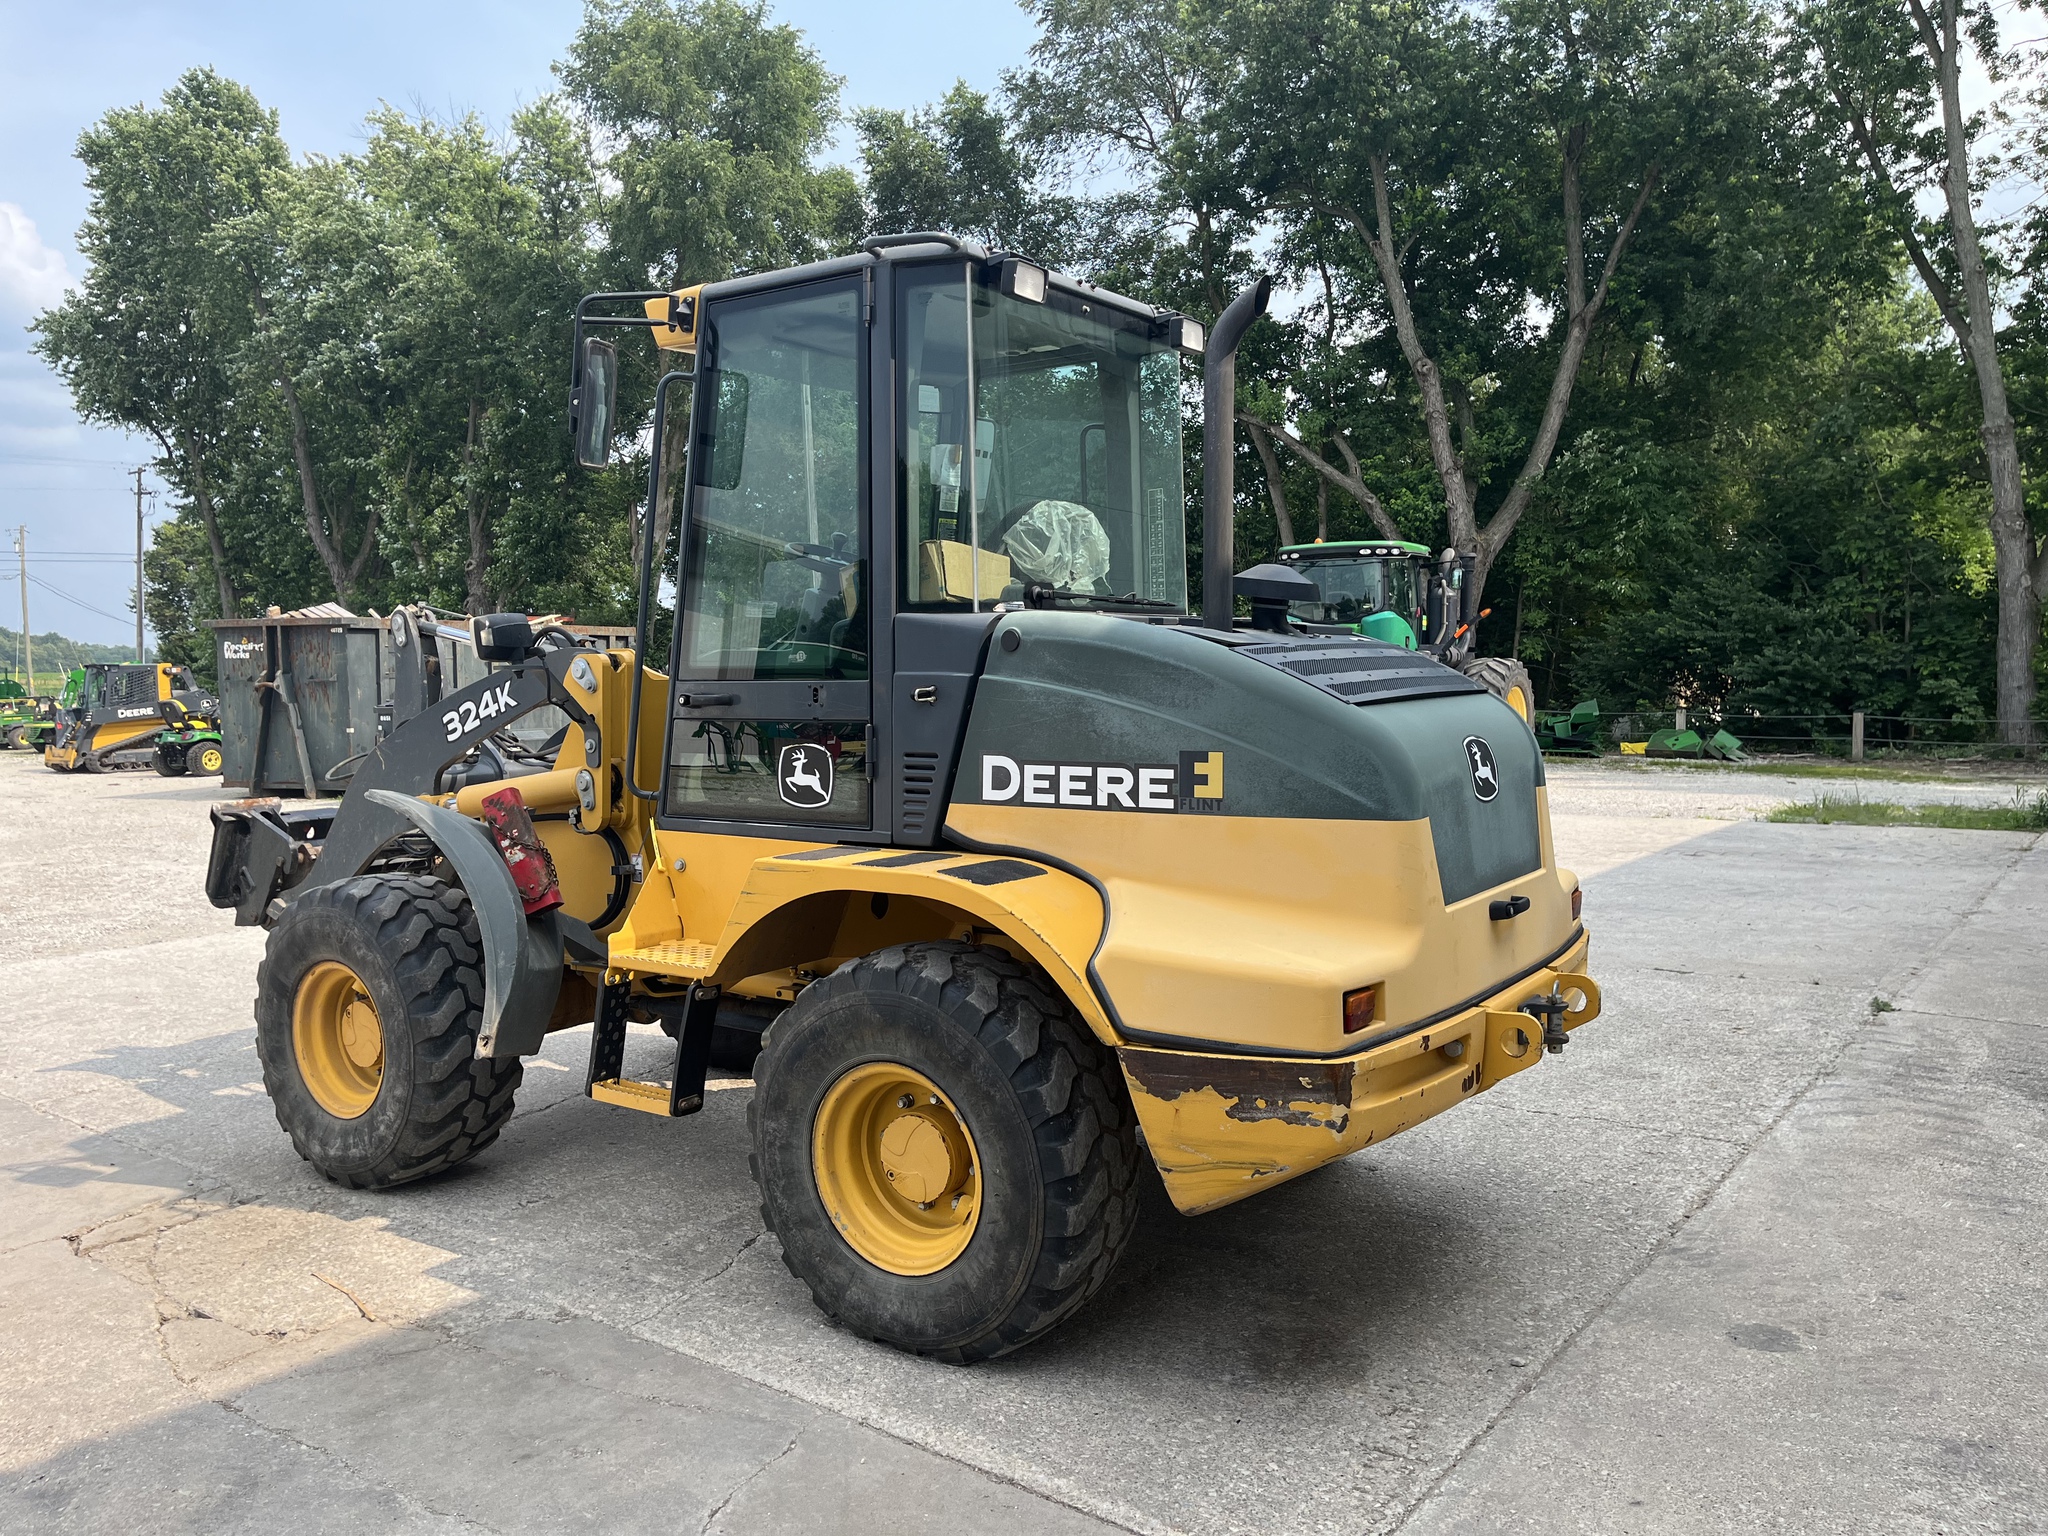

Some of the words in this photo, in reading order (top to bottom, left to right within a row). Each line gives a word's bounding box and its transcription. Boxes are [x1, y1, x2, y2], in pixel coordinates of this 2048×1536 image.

[224, 649, 251, 659] Works
[117, 706, 155, 719] DEERE
[442, 680, 518, 742] 324K
[982, 754, 1175, 810] DEERE
[1180, 798, 1223, 812] FLINT
